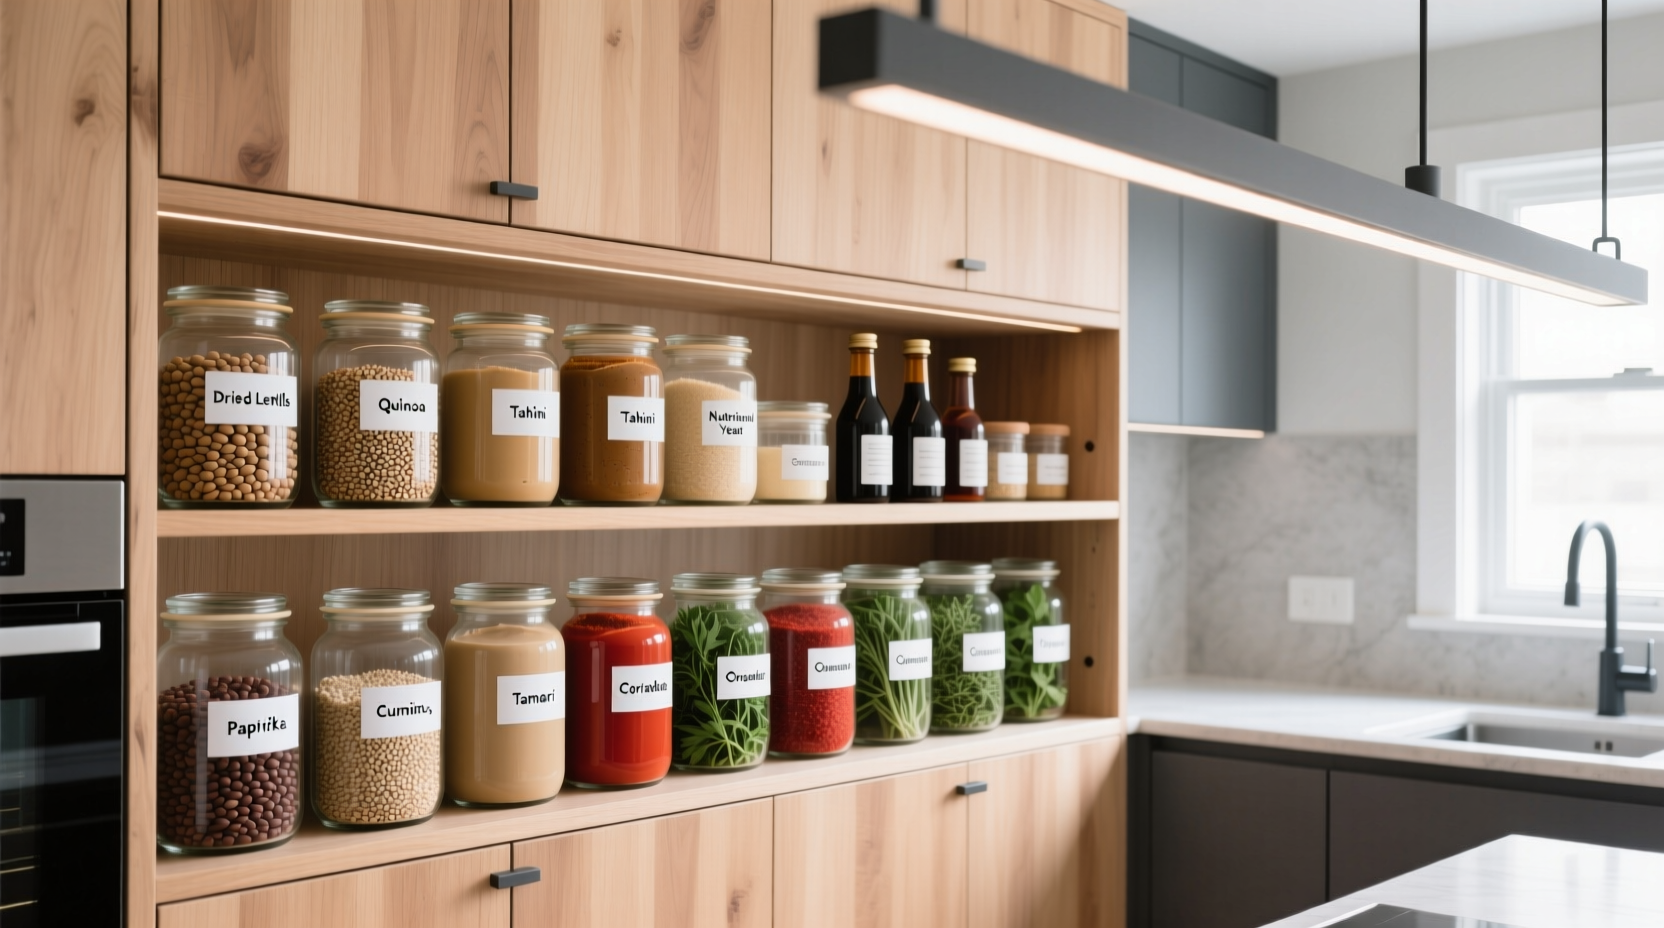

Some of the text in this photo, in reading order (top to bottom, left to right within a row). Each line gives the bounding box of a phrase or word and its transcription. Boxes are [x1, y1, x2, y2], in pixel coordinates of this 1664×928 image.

[214, 391, 251, 405] Dried
[379, 397, 425, 415] Quinoa
[510, 405, 546, 419] Tahini
[620, 411, 655, 424] Tahini
